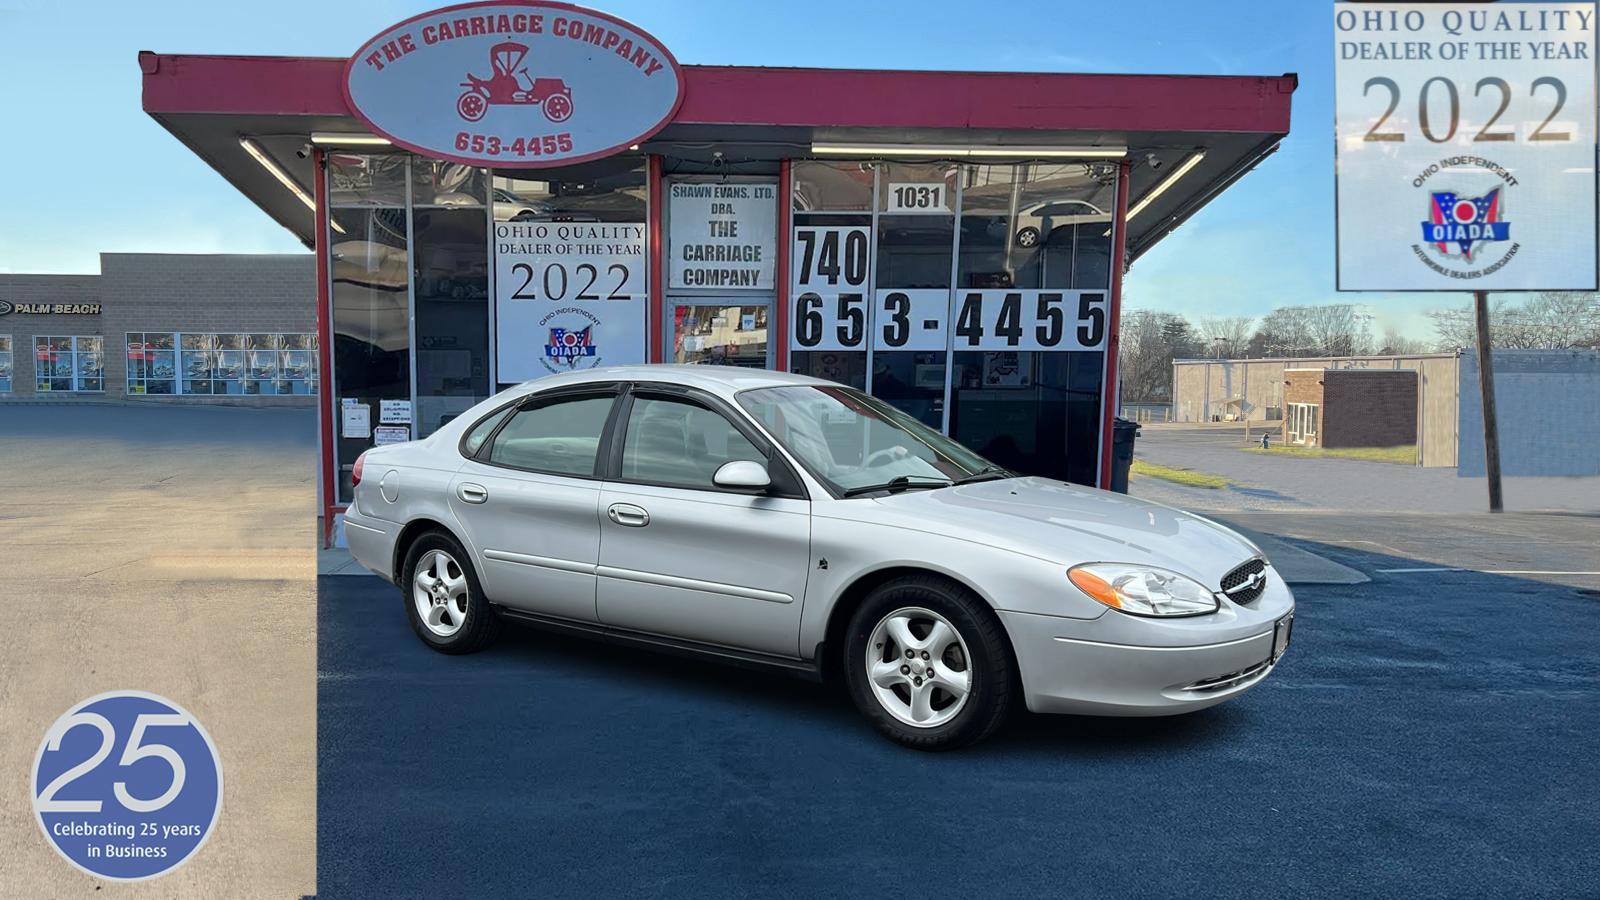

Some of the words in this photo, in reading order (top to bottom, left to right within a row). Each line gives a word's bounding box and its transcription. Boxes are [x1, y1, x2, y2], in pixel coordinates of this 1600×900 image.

[1336, 10, 1425, 32] OHIO
[1442, 10, 1592, 35] QUALITY
[366, 34, 416, 71] THE
[422, 15, 543, 45] CARRIAGE
[553, 17, 664, 77] COMPANY
[1340, 41, 1433, 60] DEALER
[1439, 41, 1469, 60] OF
[1475, 41, 1522, 60] THE
[1528, 41, 1589, 60] YEAR
[1362, 76, 1571, 143] 2022
[455, 132, 573, 156] 653-4455
[1412, 164, 1439, 188] OHIO
[1440, 156, 1519, 187] INDEPENDENT
[672, 186, 712, 198] SHAWN
[754, 187, 774, 199] LTD.
[894, 186, 941, 208] 1031
[711, 203, 736, 215] DBA.
[497, 226, 548, 239] OHIO
[558, 226, 644, 241] QUALITY
[708, 221, 737, 238] THE
[1433, 224, 1495, 240] OIADA
[500, 244, 552, 255] DEALER
[556, 244, 573, 255] OF
[576, 244, 603, 255] THE
[605, 244, 641, 255] YEAR
[683, 245, 762, 262] CARRIAGE
[797, 230, 868, 286] 740
[511, 263, 631, 301] 2022
[683, 269, 760, 286] COMPANY
[15, 303, 51, 314] PALM
[54, 304, 100, 314] BEACH
[555, 307, 601, 326] INDEPENDENT
[551, 347, 588, 356] OIADA
